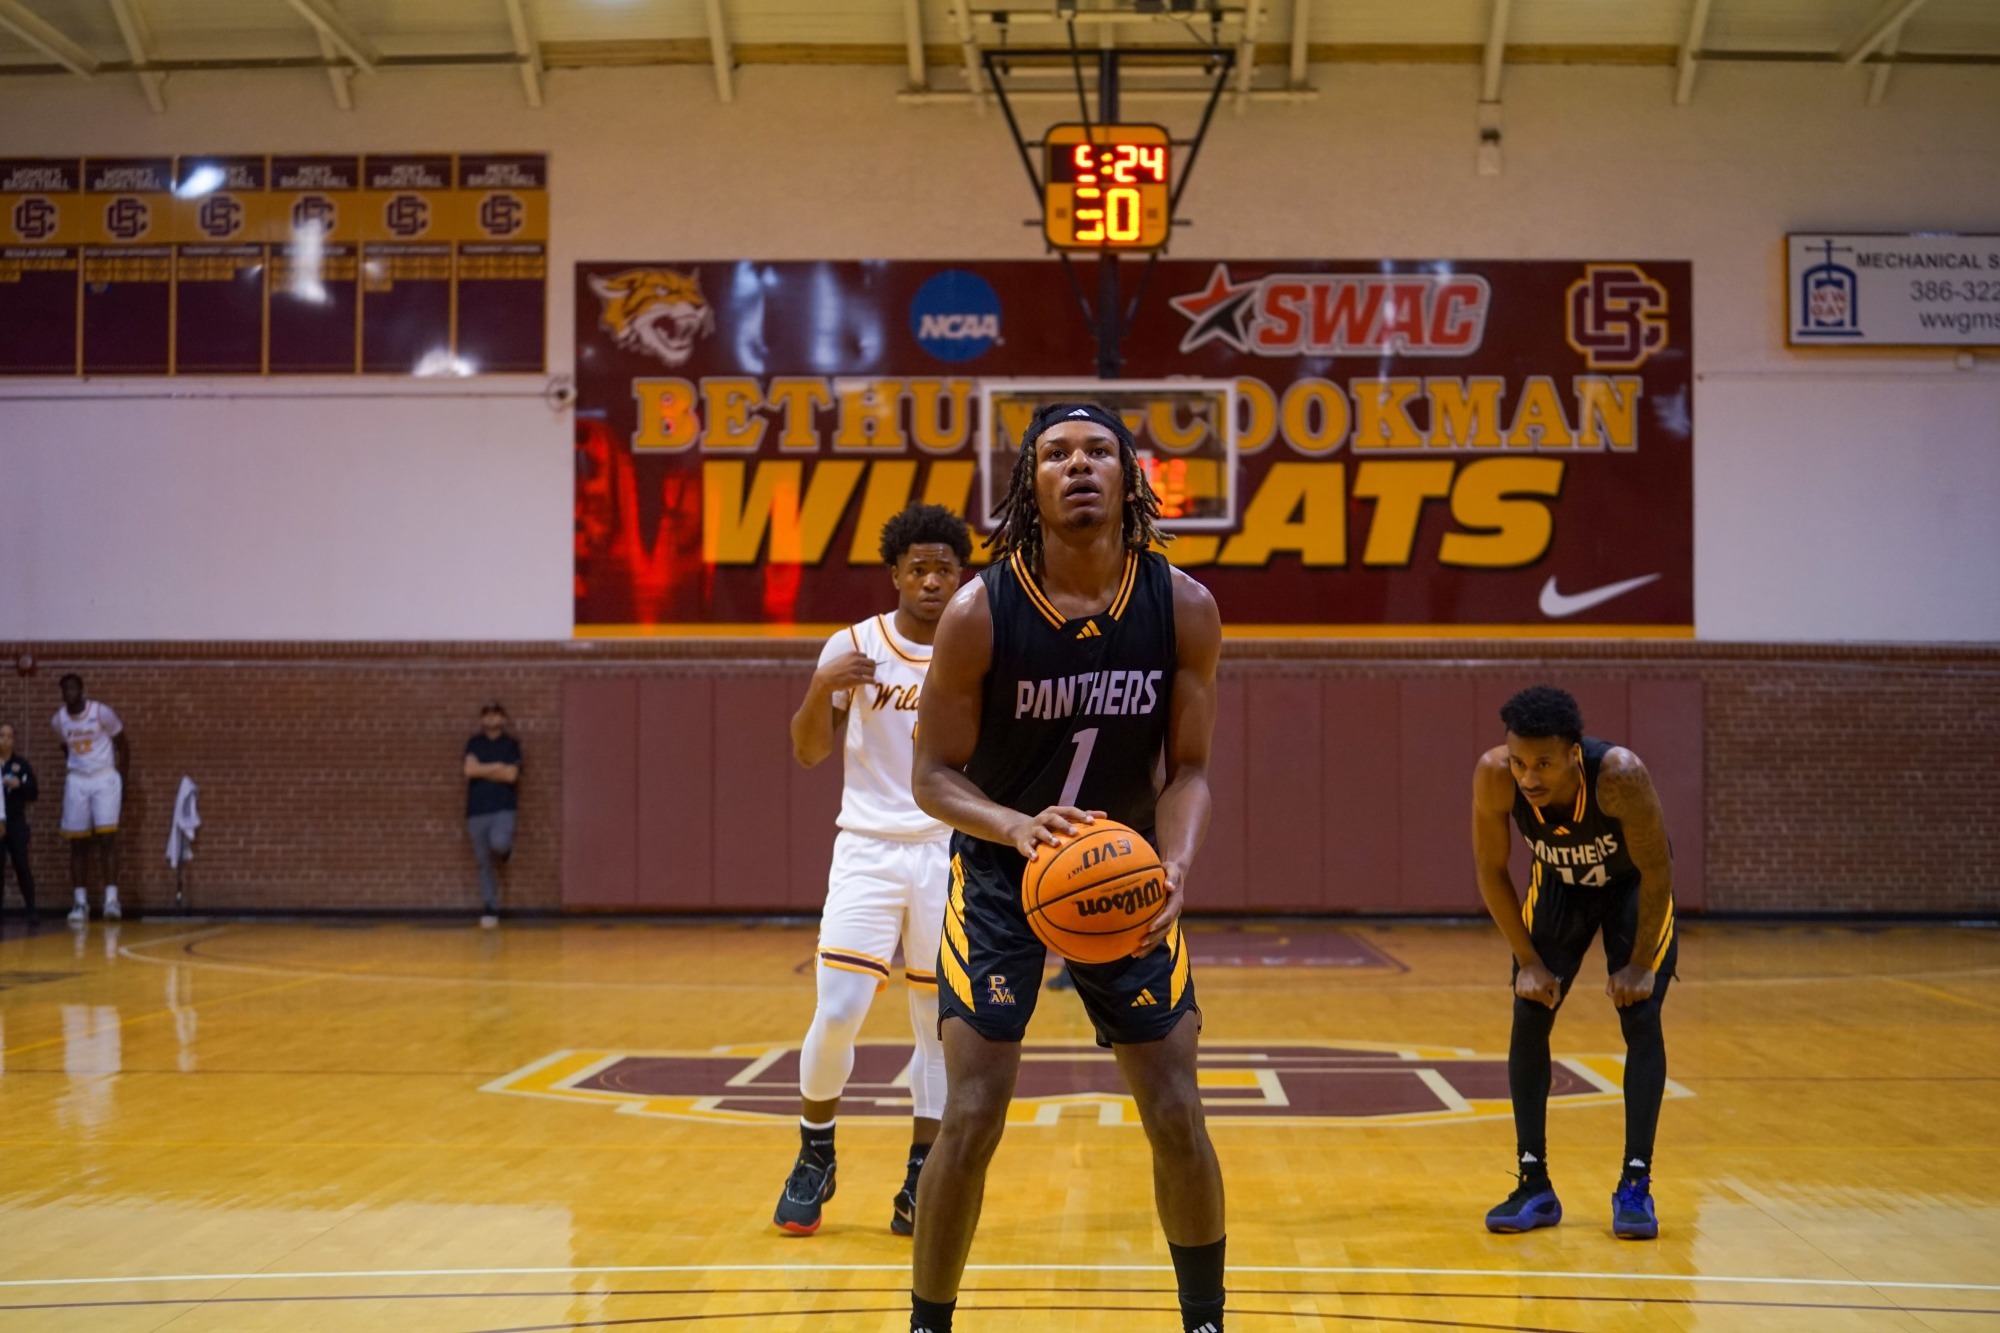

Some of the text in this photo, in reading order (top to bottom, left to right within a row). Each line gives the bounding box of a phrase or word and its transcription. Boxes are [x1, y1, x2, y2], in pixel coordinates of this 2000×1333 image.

[1856, 252, 1982, 269] MECHANICAL
[1910, 280, 2000, 302] 386-322
[918, 313, 999, 339] NCAA
[1252, 277, 1488, 353] SWAC
[1919, 312, 2000, 334] wwgms
[1015, 670, 1163, 720] PANTHERS
[1058, 728, 1099, 807] 1
[1556, 864, 1612, 888] 14
[1076, 877, 1162, 917] Wilson
